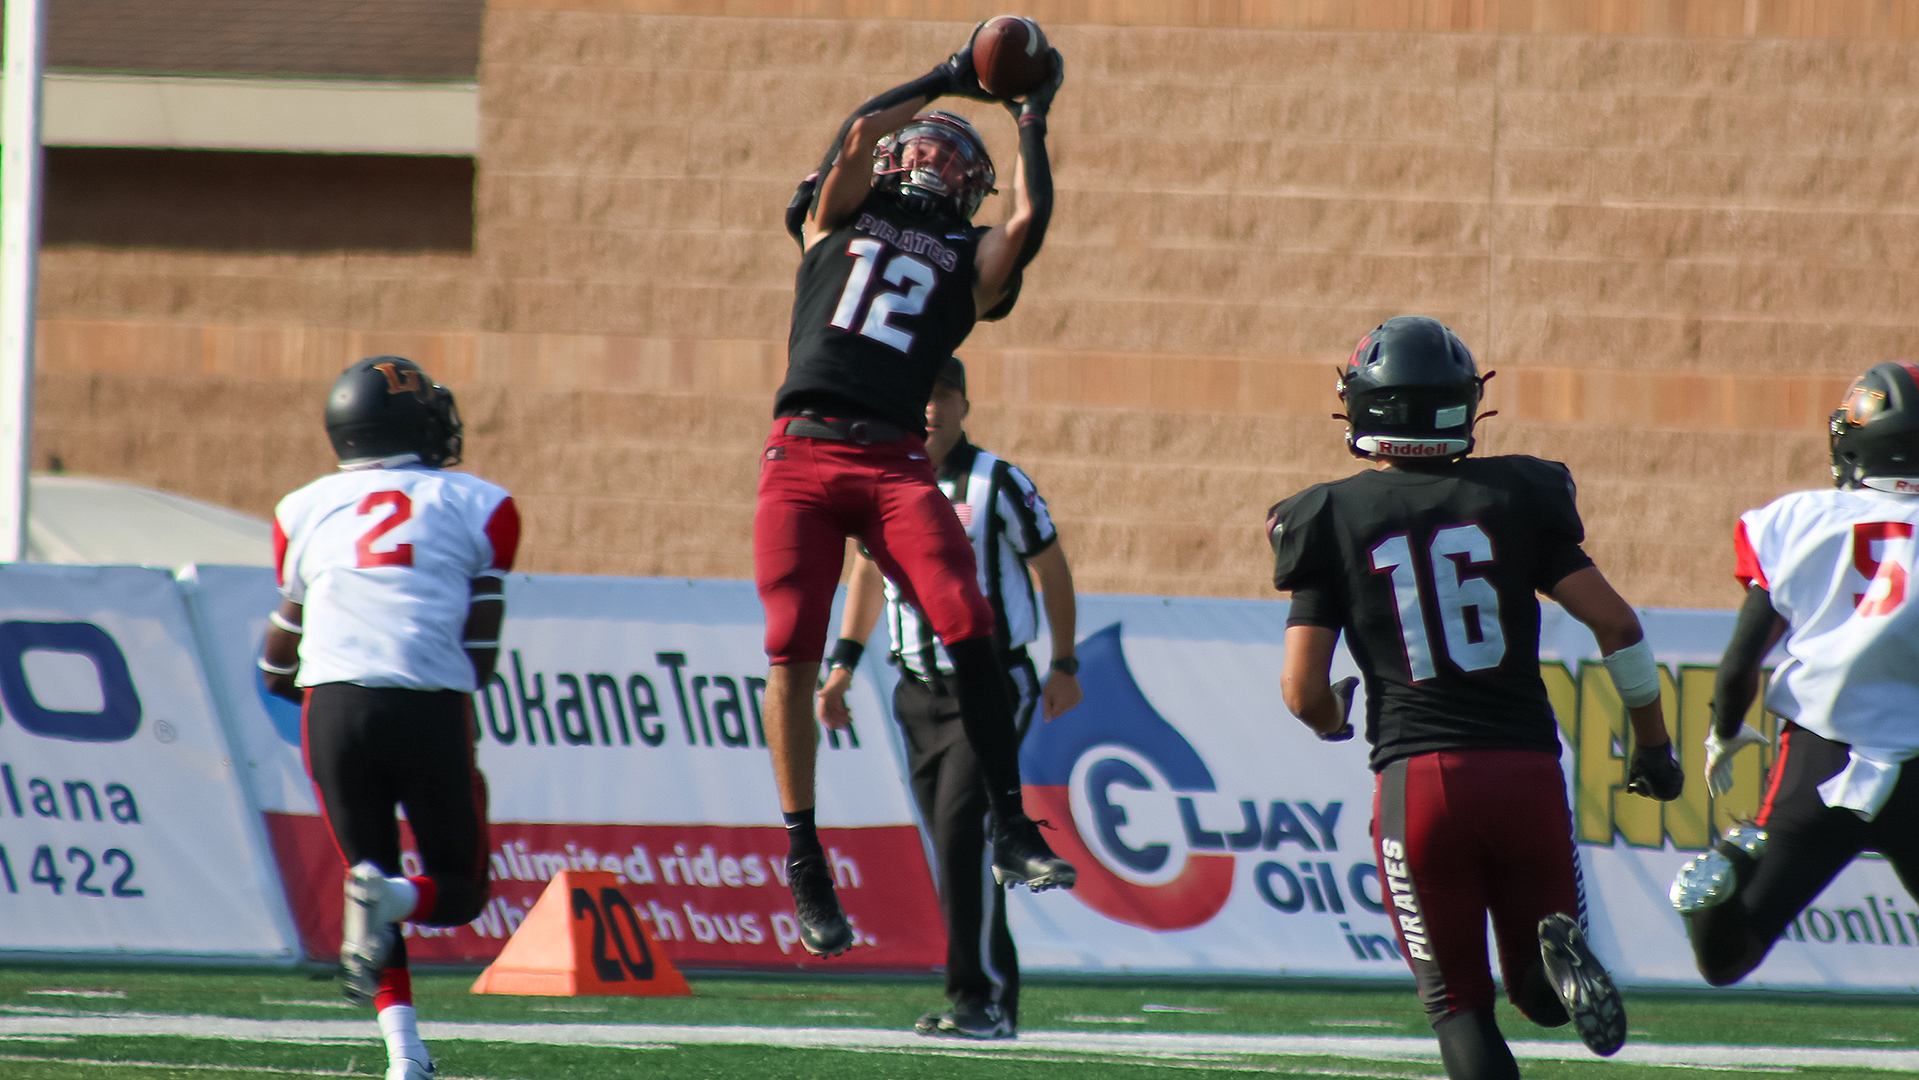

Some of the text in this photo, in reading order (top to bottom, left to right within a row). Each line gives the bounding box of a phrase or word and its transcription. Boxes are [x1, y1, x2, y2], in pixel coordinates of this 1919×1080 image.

[855, 213, 958, 273] PIRATES
[828, 238, 937, 354] 12
[1379, 441, 1448, 457] Riddell
[355, 490, 414, 569] 2
[1368, 523, 1507, 686] 16
[1853, 521, 1914, 618] 5
[474, 649, 660, 748] okane
[658, 843, 767, 887] rides
[1254, 860, 1346, 914] Oil
[1382, 837, 1433, 962] PIRATES
[572, 887, 655, 982] 20
[683, 902, 765, 944] bus
[1339, 901, 1406, 960] in
